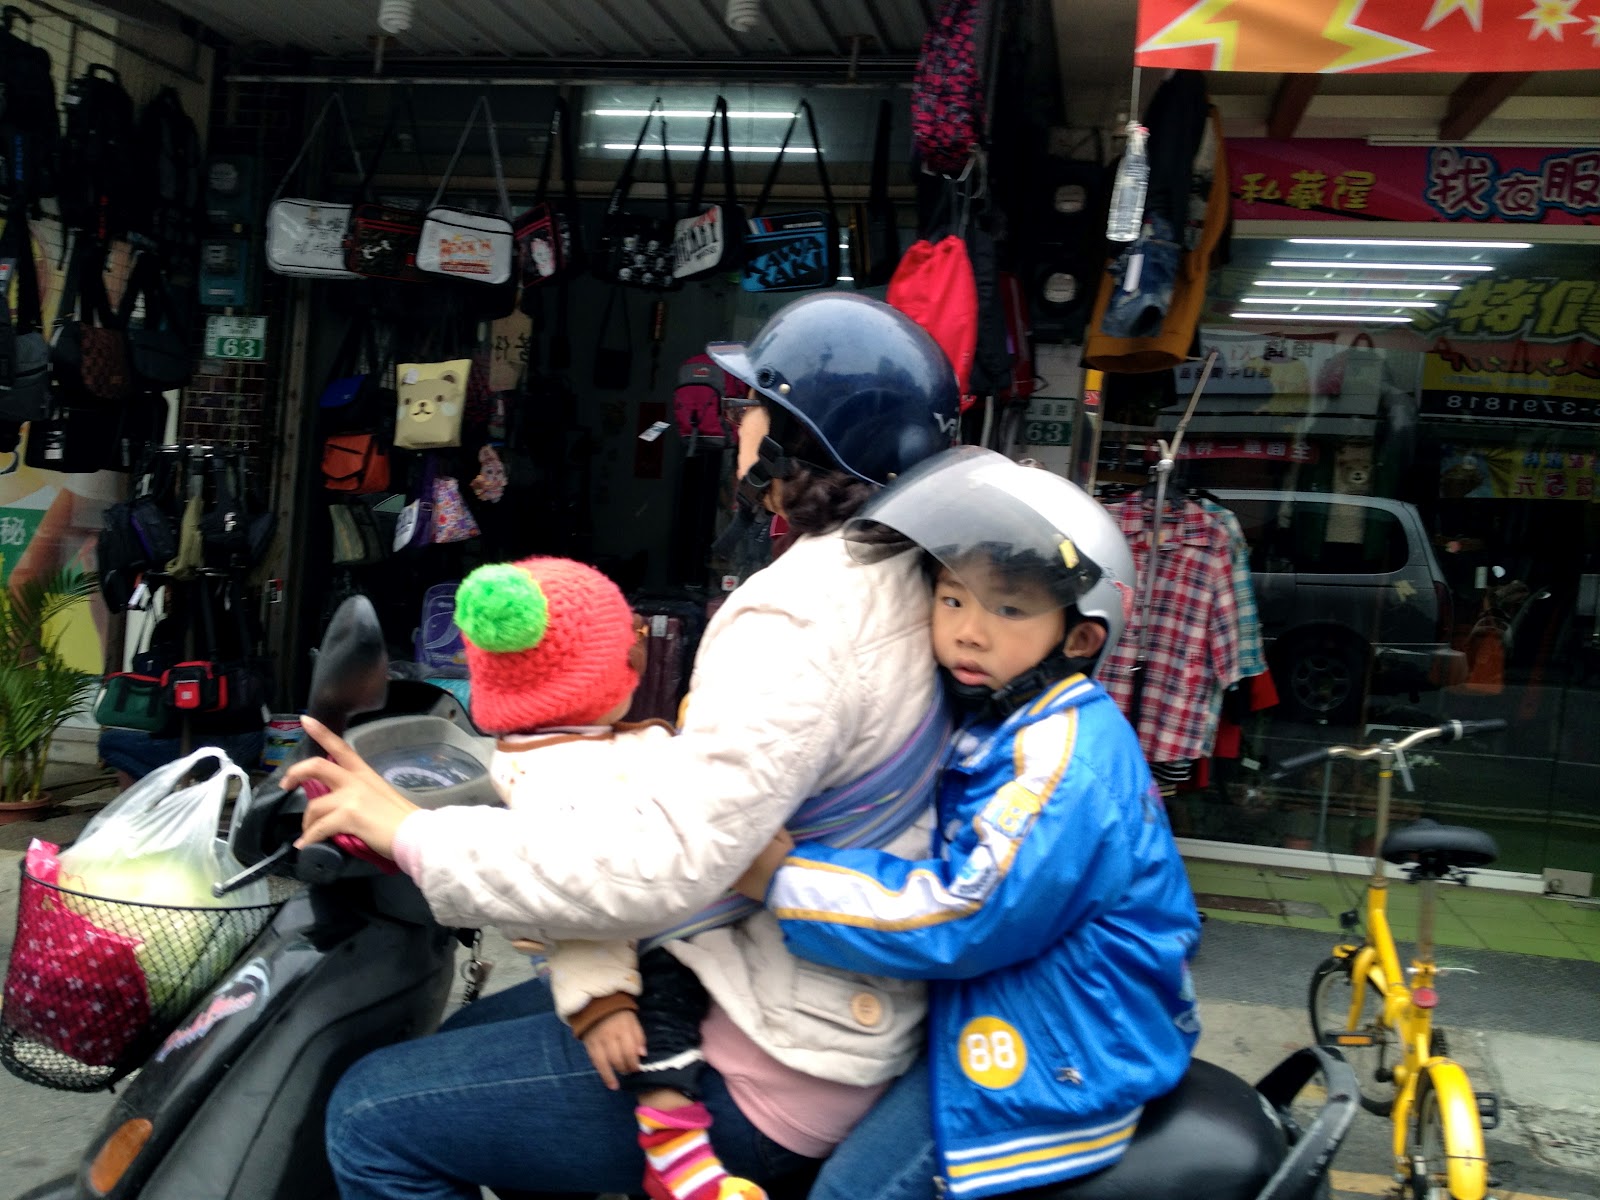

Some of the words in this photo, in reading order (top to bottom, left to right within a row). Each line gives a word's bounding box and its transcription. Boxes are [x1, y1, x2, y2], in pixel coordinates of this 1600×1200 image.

[222, 338, 256, 357] 63
[1024, 422, 1064, 442] 63
[966, 1031, 1018, 1072] 88
